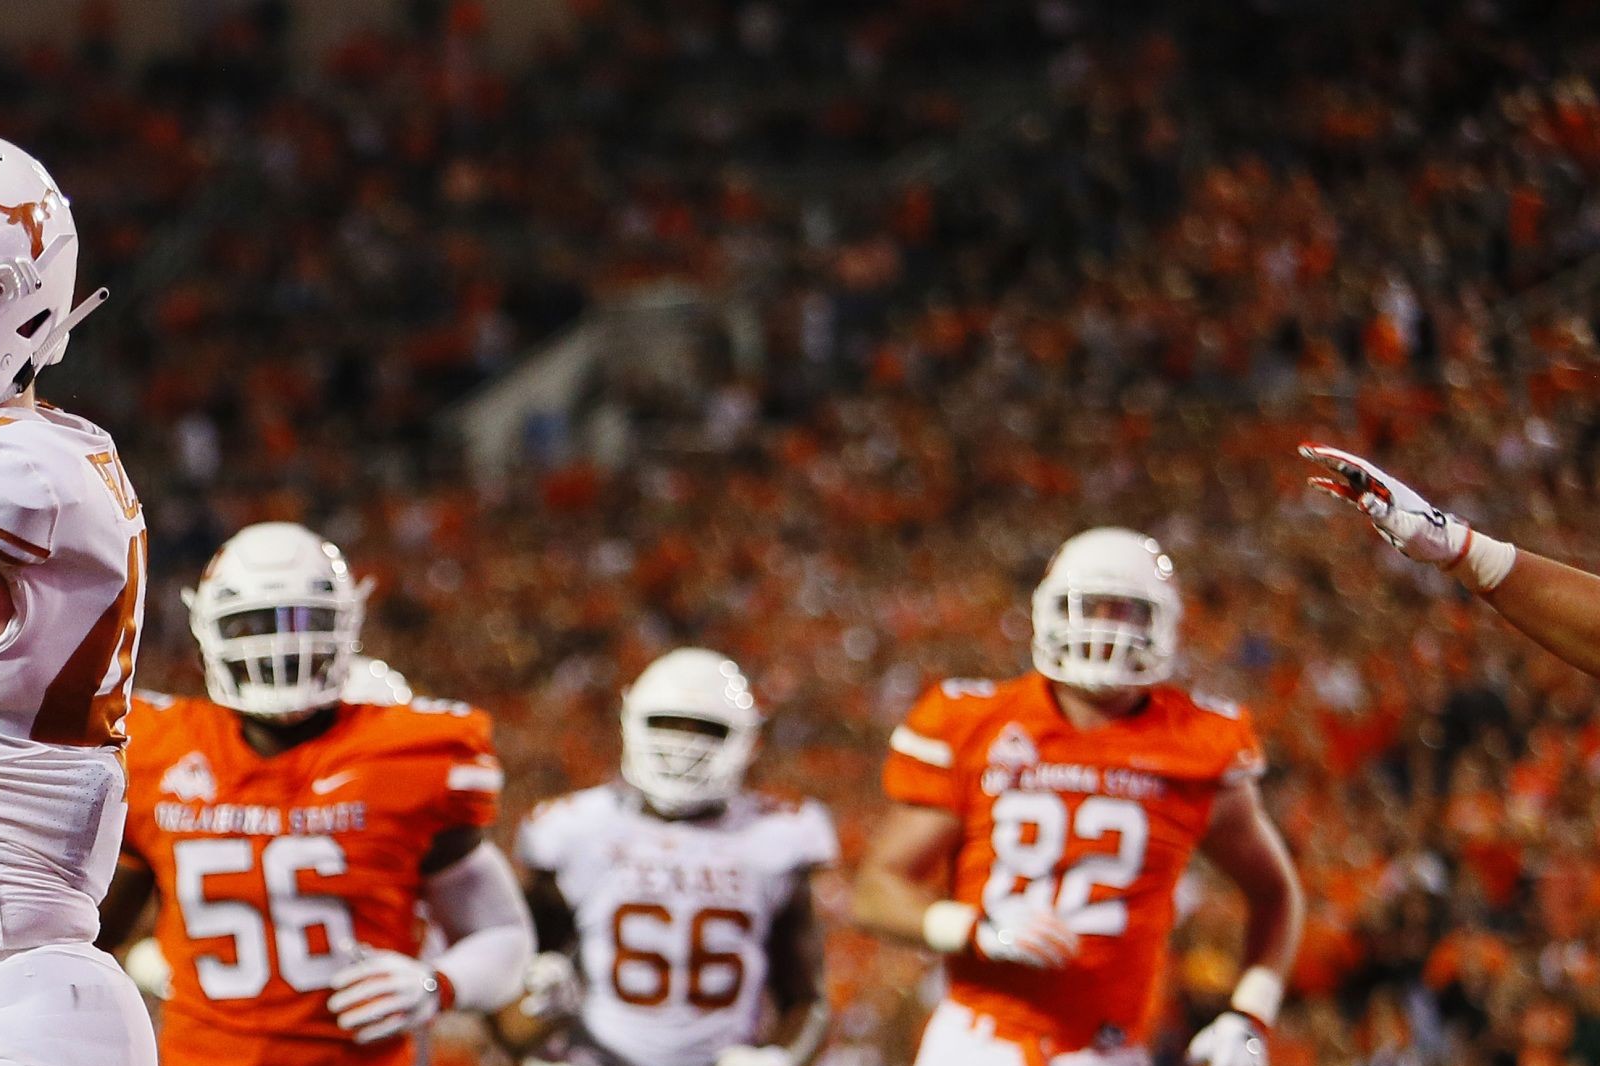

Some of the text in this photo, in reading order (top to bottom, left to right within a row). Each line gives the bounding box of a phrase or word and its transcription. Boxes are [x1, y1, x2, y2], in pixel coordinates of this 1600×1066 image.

[173, 834, 358, 1001] 56
[982, 790, 1150, 937] 82
[612, 903, 752, 1009] 66
